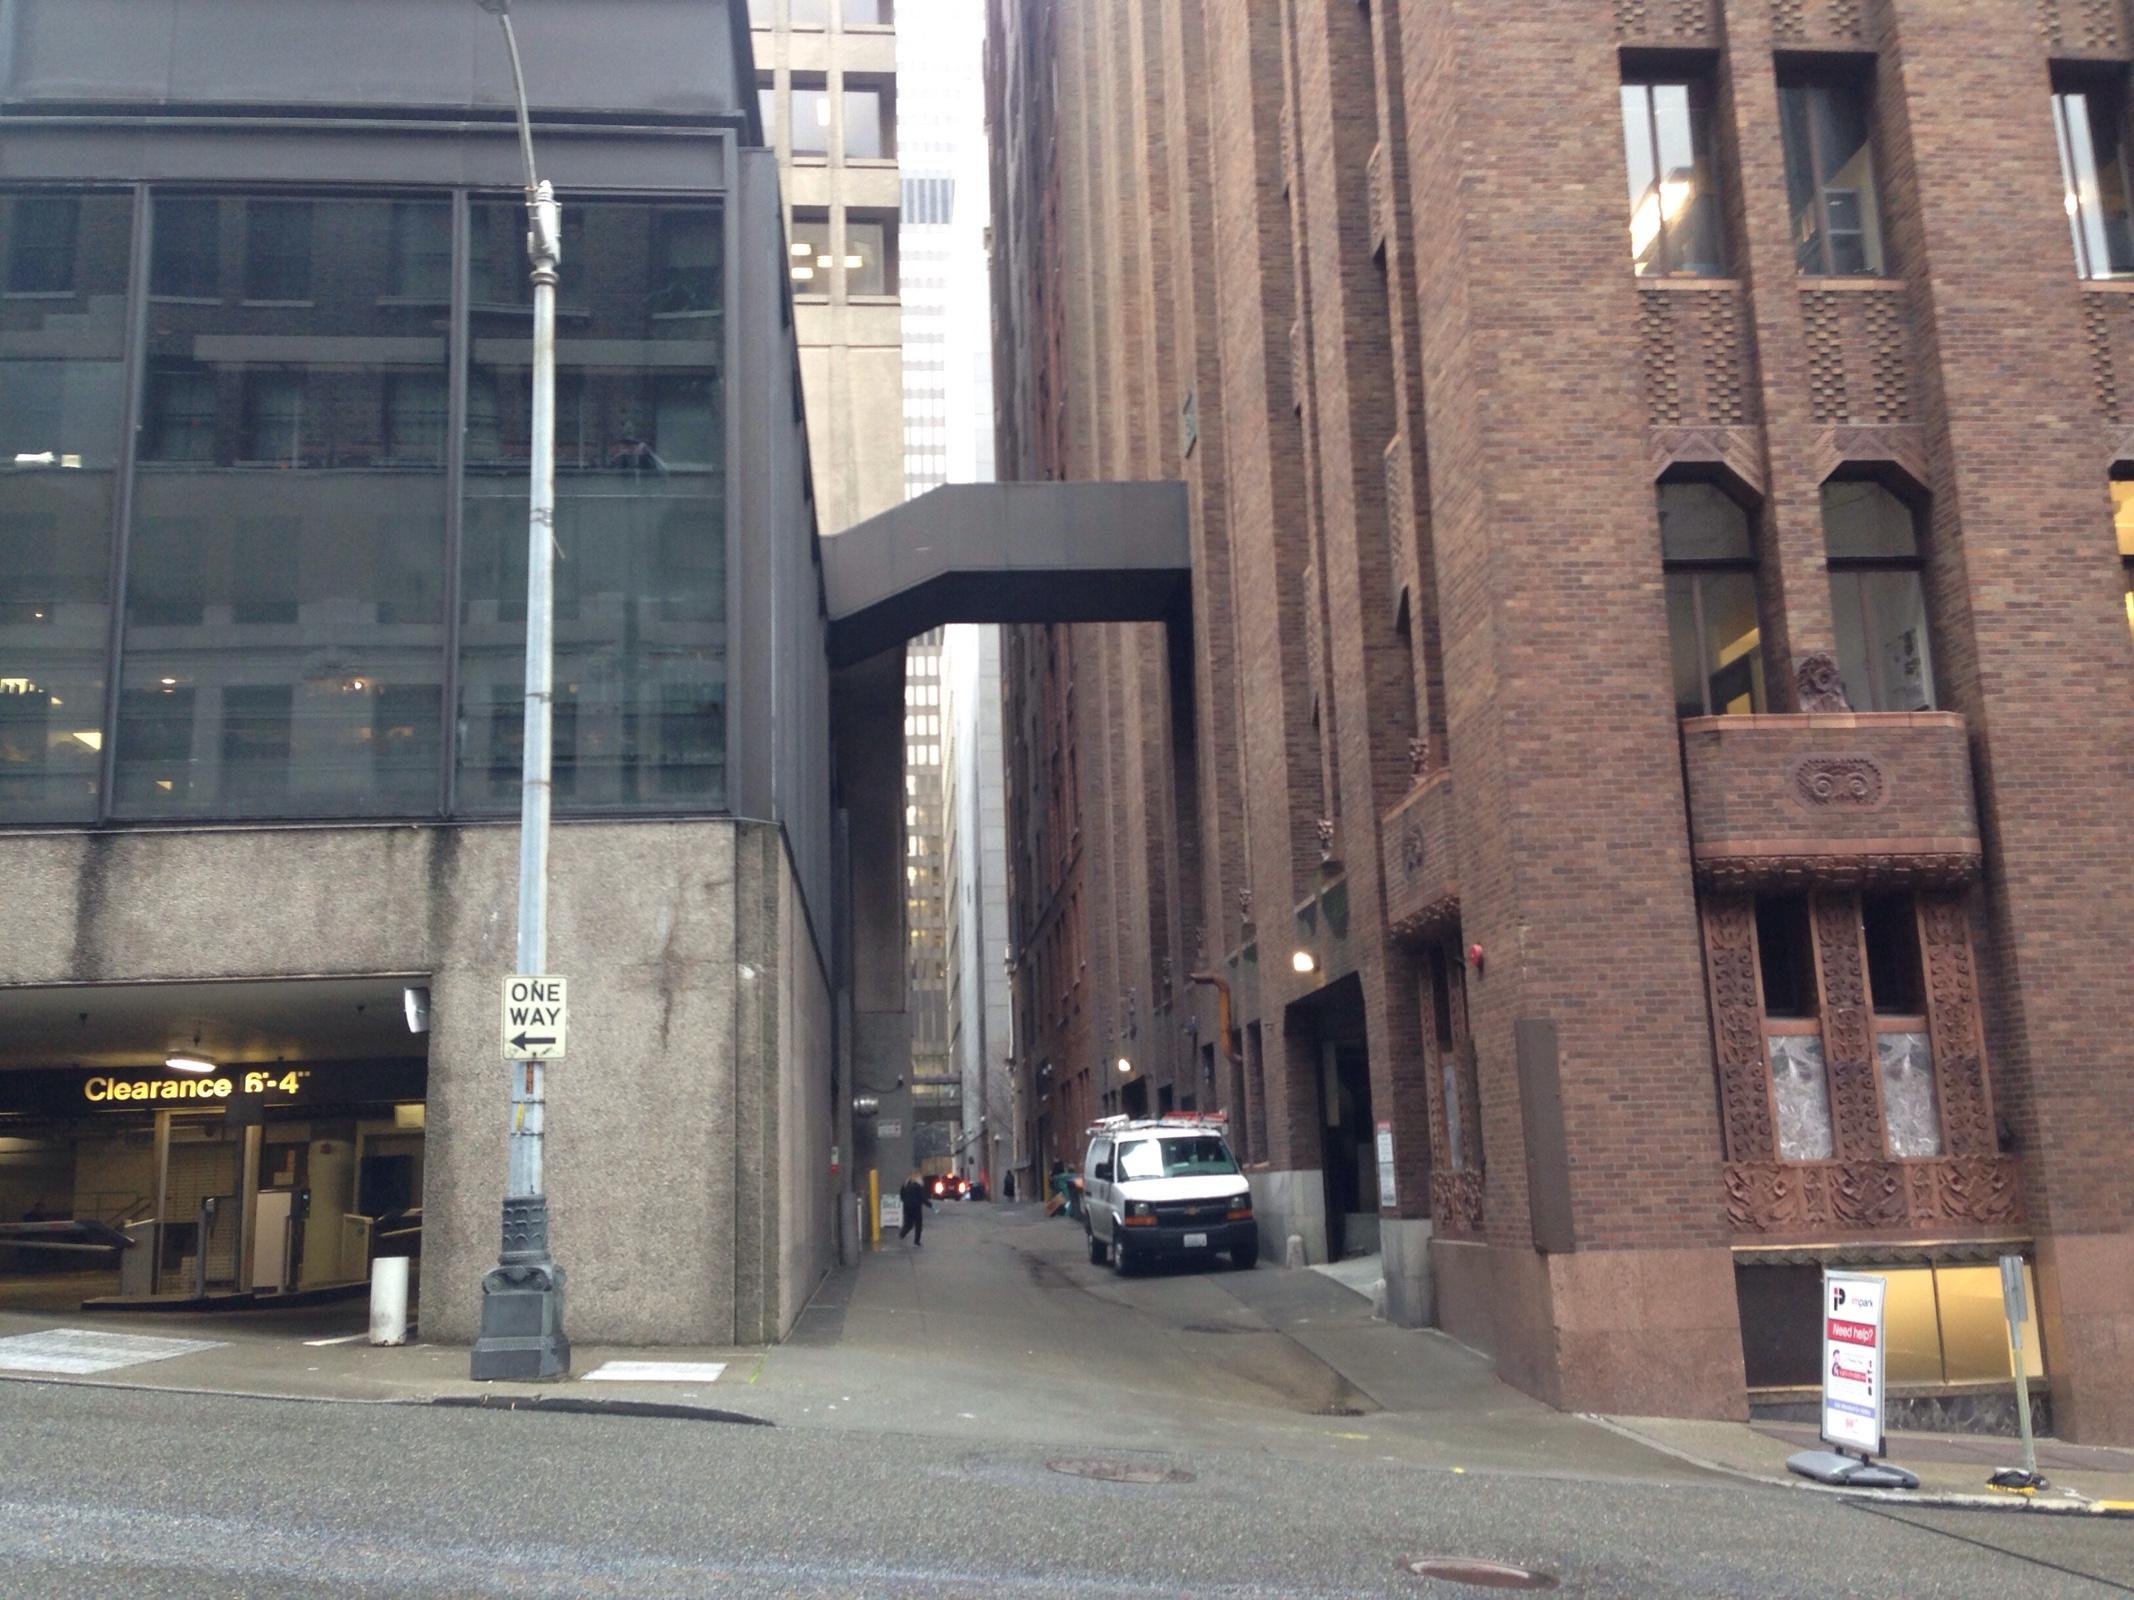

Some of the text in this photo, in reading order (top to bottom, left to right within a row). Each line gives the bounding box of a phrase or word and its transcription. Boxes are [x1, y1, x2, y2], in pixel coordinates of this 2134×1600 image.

[511, 983, 560, 1002] ONE
[510, 1007, 561, 1026] WAY
[84, 1077, 232, 1101] Clearance
[1832, 1323, 1874, 1343] Need help?
